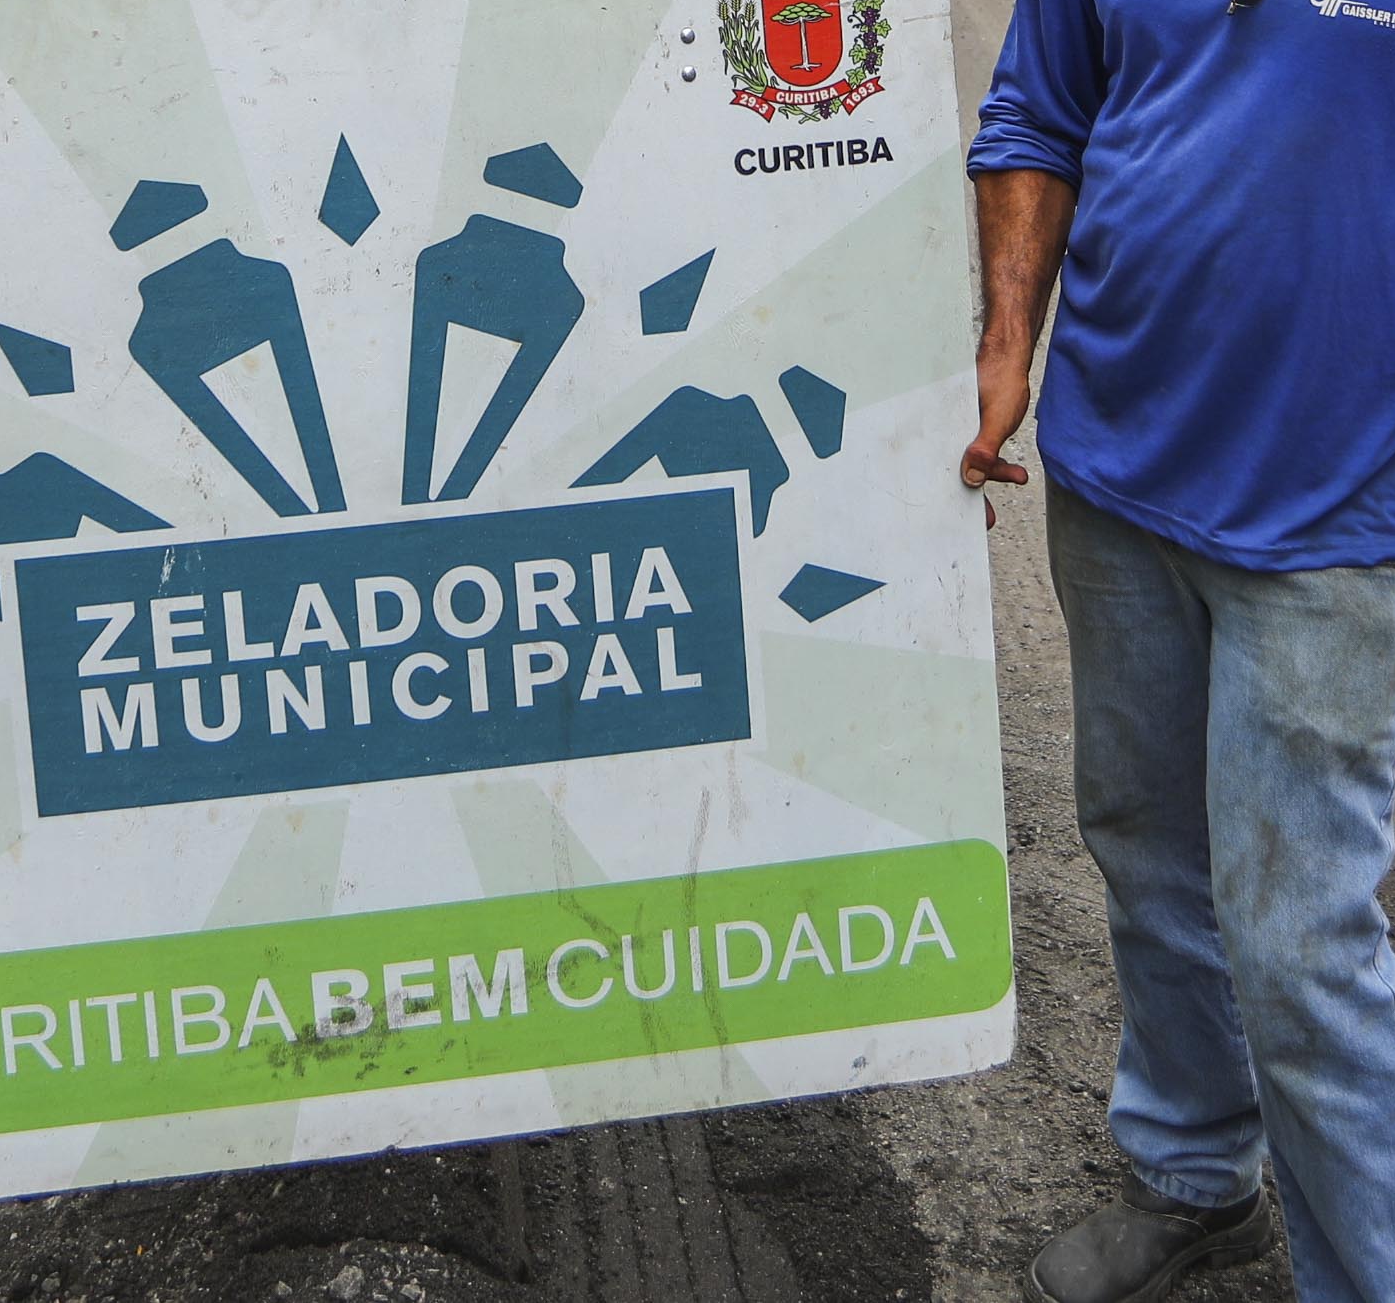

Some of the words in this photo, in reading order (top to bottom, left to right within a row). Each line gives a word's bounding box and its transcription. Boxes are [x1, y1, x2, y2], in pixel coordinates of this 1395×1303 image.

[1342, 4, 1391, 23] GAISSLER
[739, 94, 769, 115] 29-3
[776, 87, 839, 104] CURITIBA
[846, 84, 876, 109] 1693
[734, 137, 894, 176] CURITIBA
[75, 546, 693, 677] ZELADORIA
[80, 626, 702, 754] MUNICIPAL
